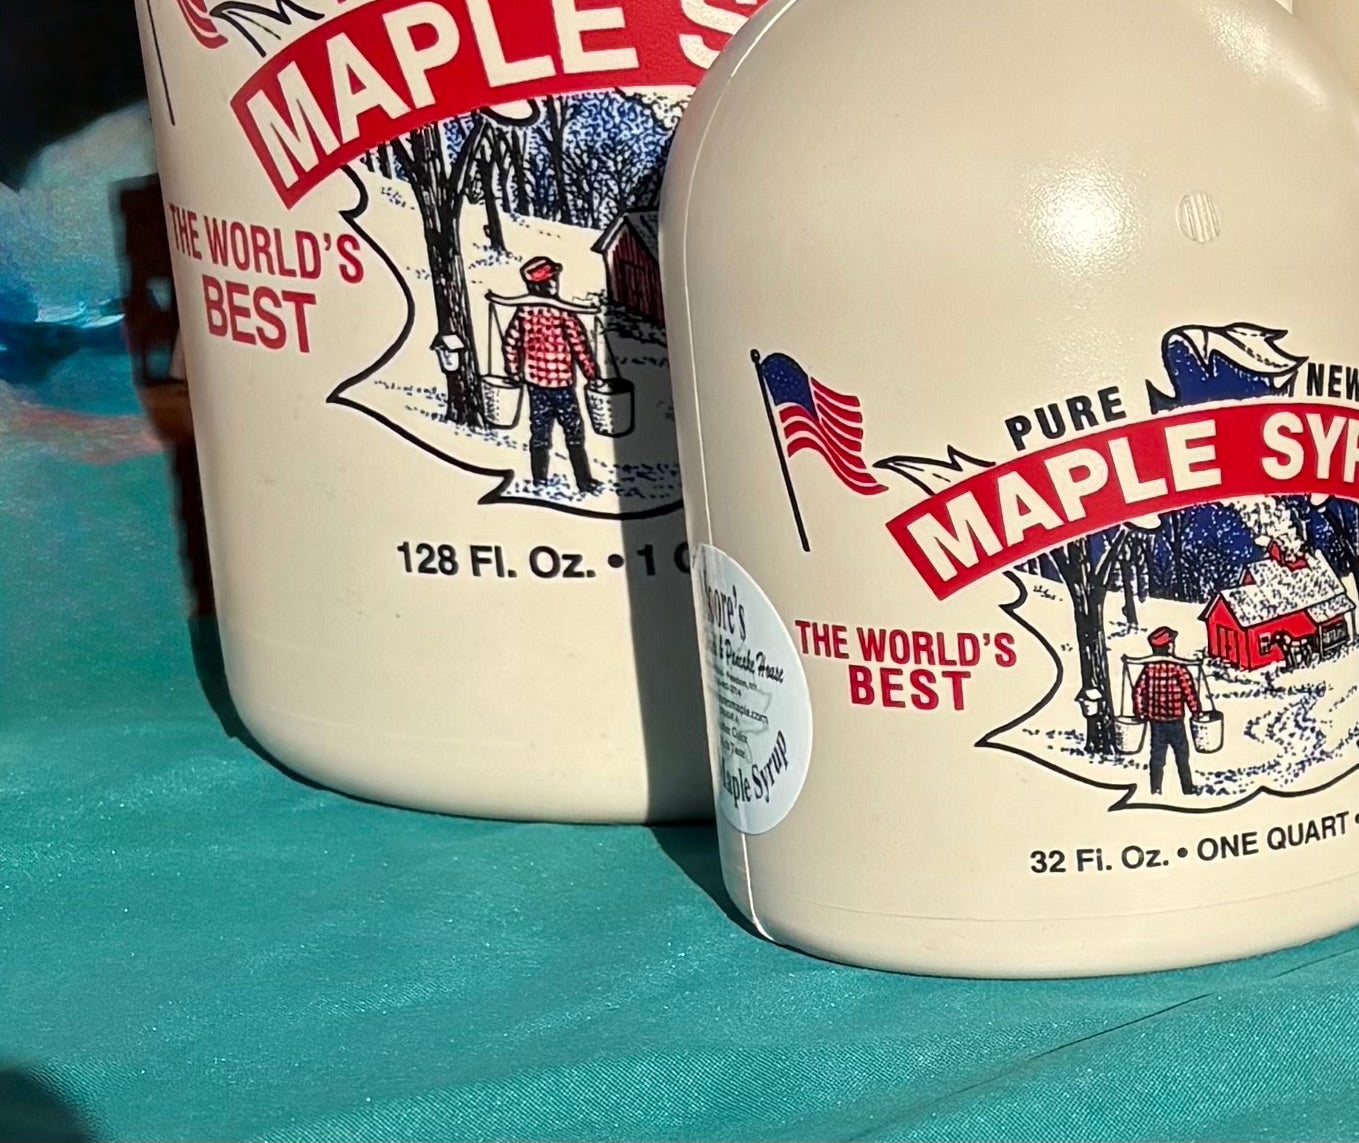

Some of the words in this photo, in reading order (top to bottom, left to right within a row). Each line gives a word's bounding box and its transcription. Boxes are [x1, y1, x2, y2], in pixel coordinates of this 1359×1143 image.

[169, 202, 203, 262] THE
[202, 213, 364, 285] WORLD'S
[202, 276, 317, 354] BEST
[1005, 386, 1128, 453] PURE
[906, 418, 1223, 584] MAPLE
[397, 541, 460, 576] 128
[529, 545, 597, 579] Oz.
[636, 544, 656, 576] 1
[795, 620, 848, 660] THE
[854, 627, 1018, 669] WORLD'S
[848, 665, 971, 712] BEST
[751, 729, 788, 803] Syrup
[1030, 849, 1067, 874] 32
[1121, 845, 1169, 869] Oz.
[1197, 831, 1259, 863] ONE
[1266, 810, 1349, 850] QUART
